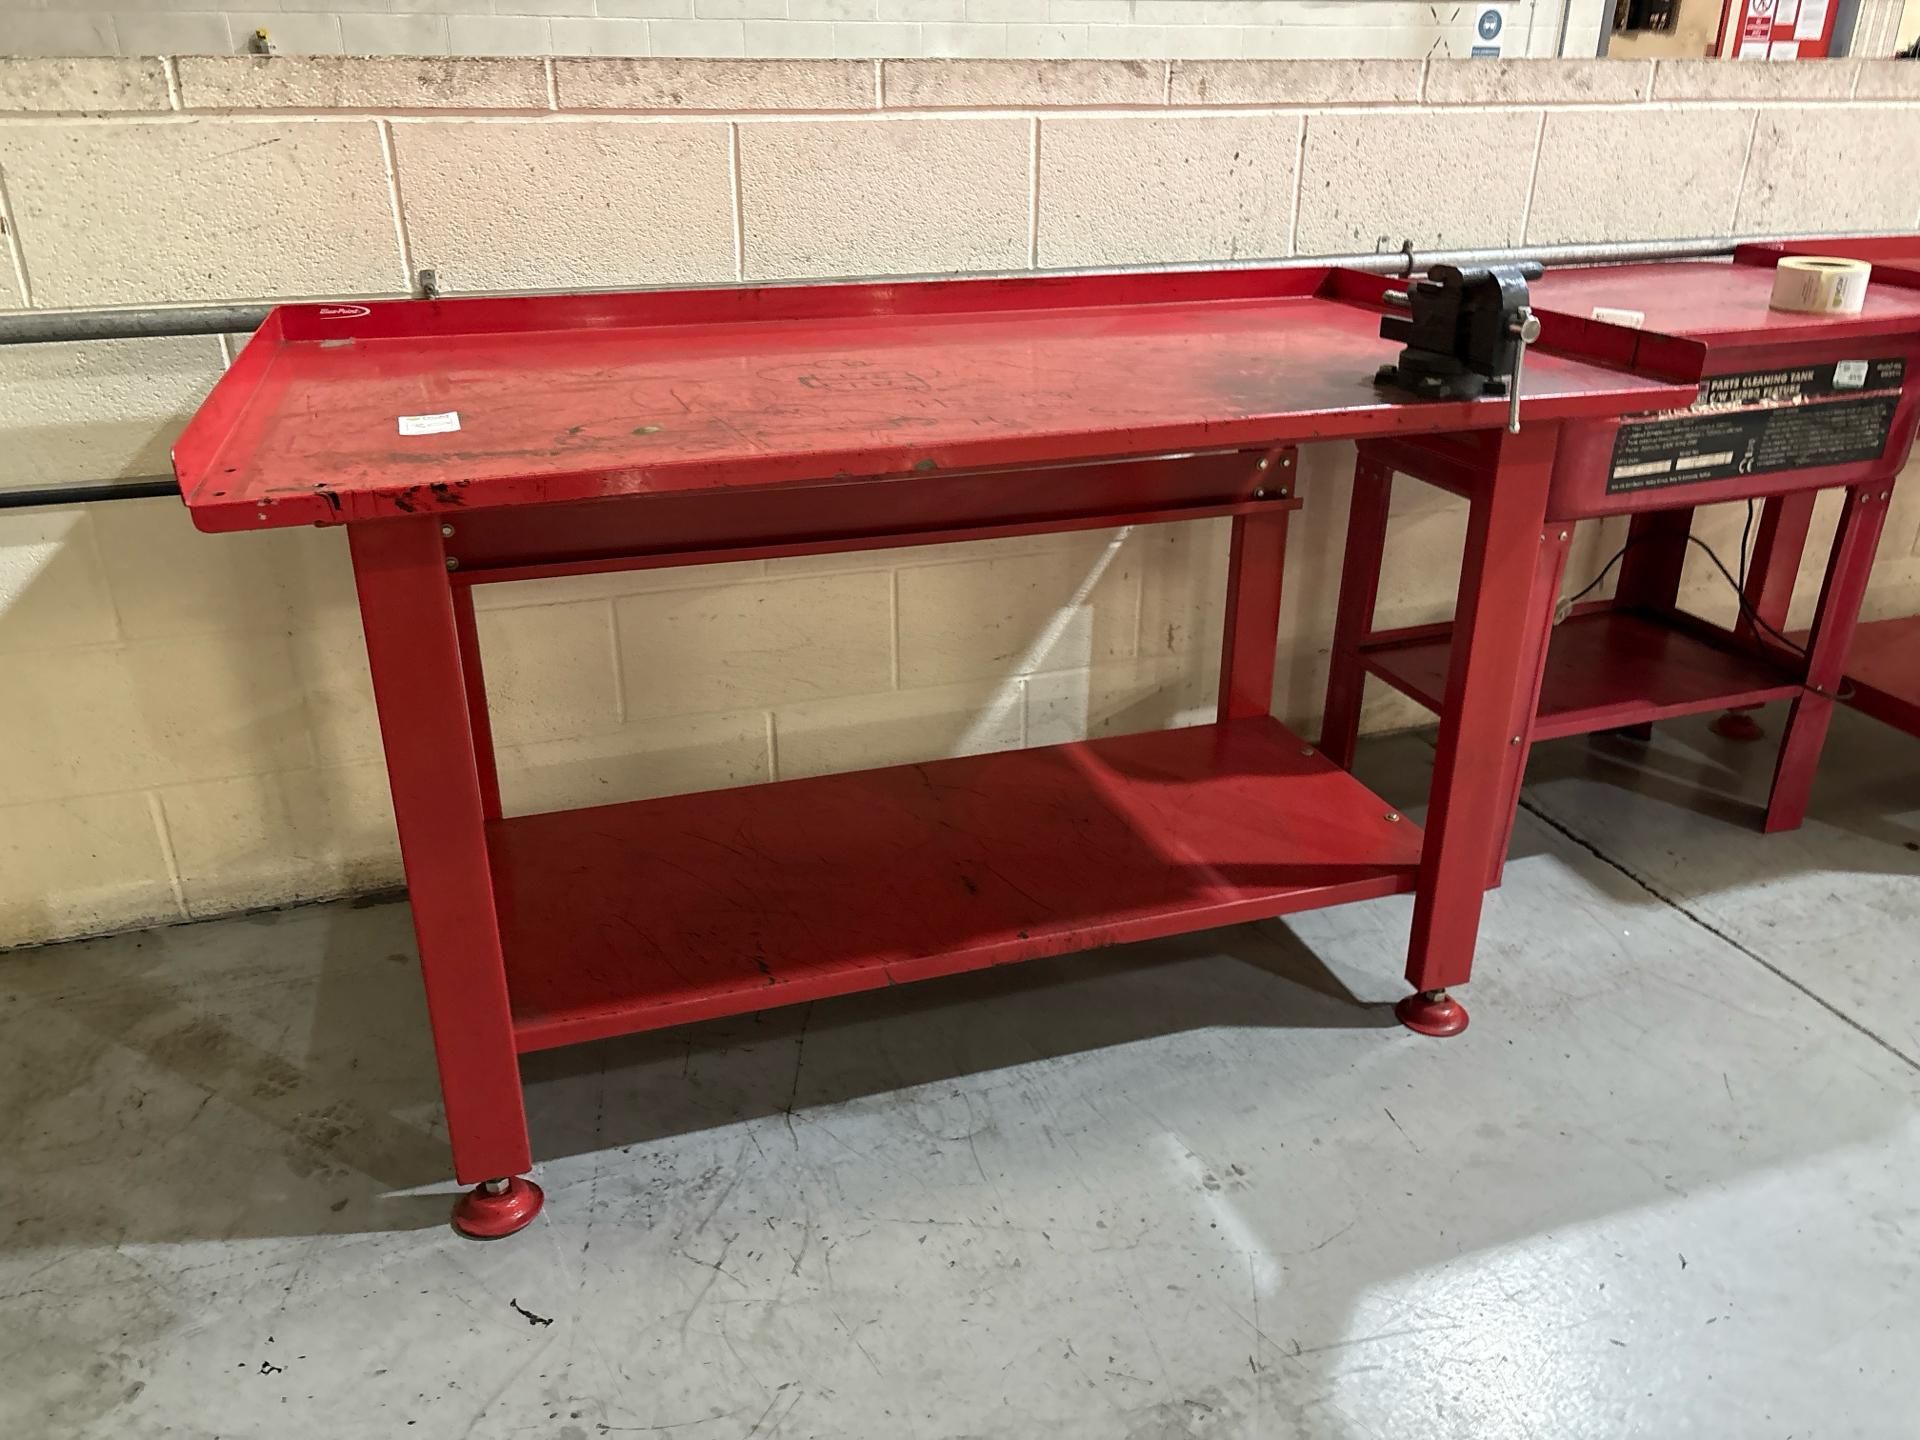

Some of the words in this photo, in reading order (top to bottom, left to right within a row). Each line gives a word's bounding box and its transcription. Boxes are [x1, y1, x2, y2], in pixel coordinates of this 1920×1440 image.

[1711, 377, 1740, 391] PARTS
[1742, 373, 1788, 388] CLEANING
[1790, 370, 1814, 383] TANK
[1730, 388, 1760, 402] TURBO
[1763, 384, 1801, 398] FEATURE
